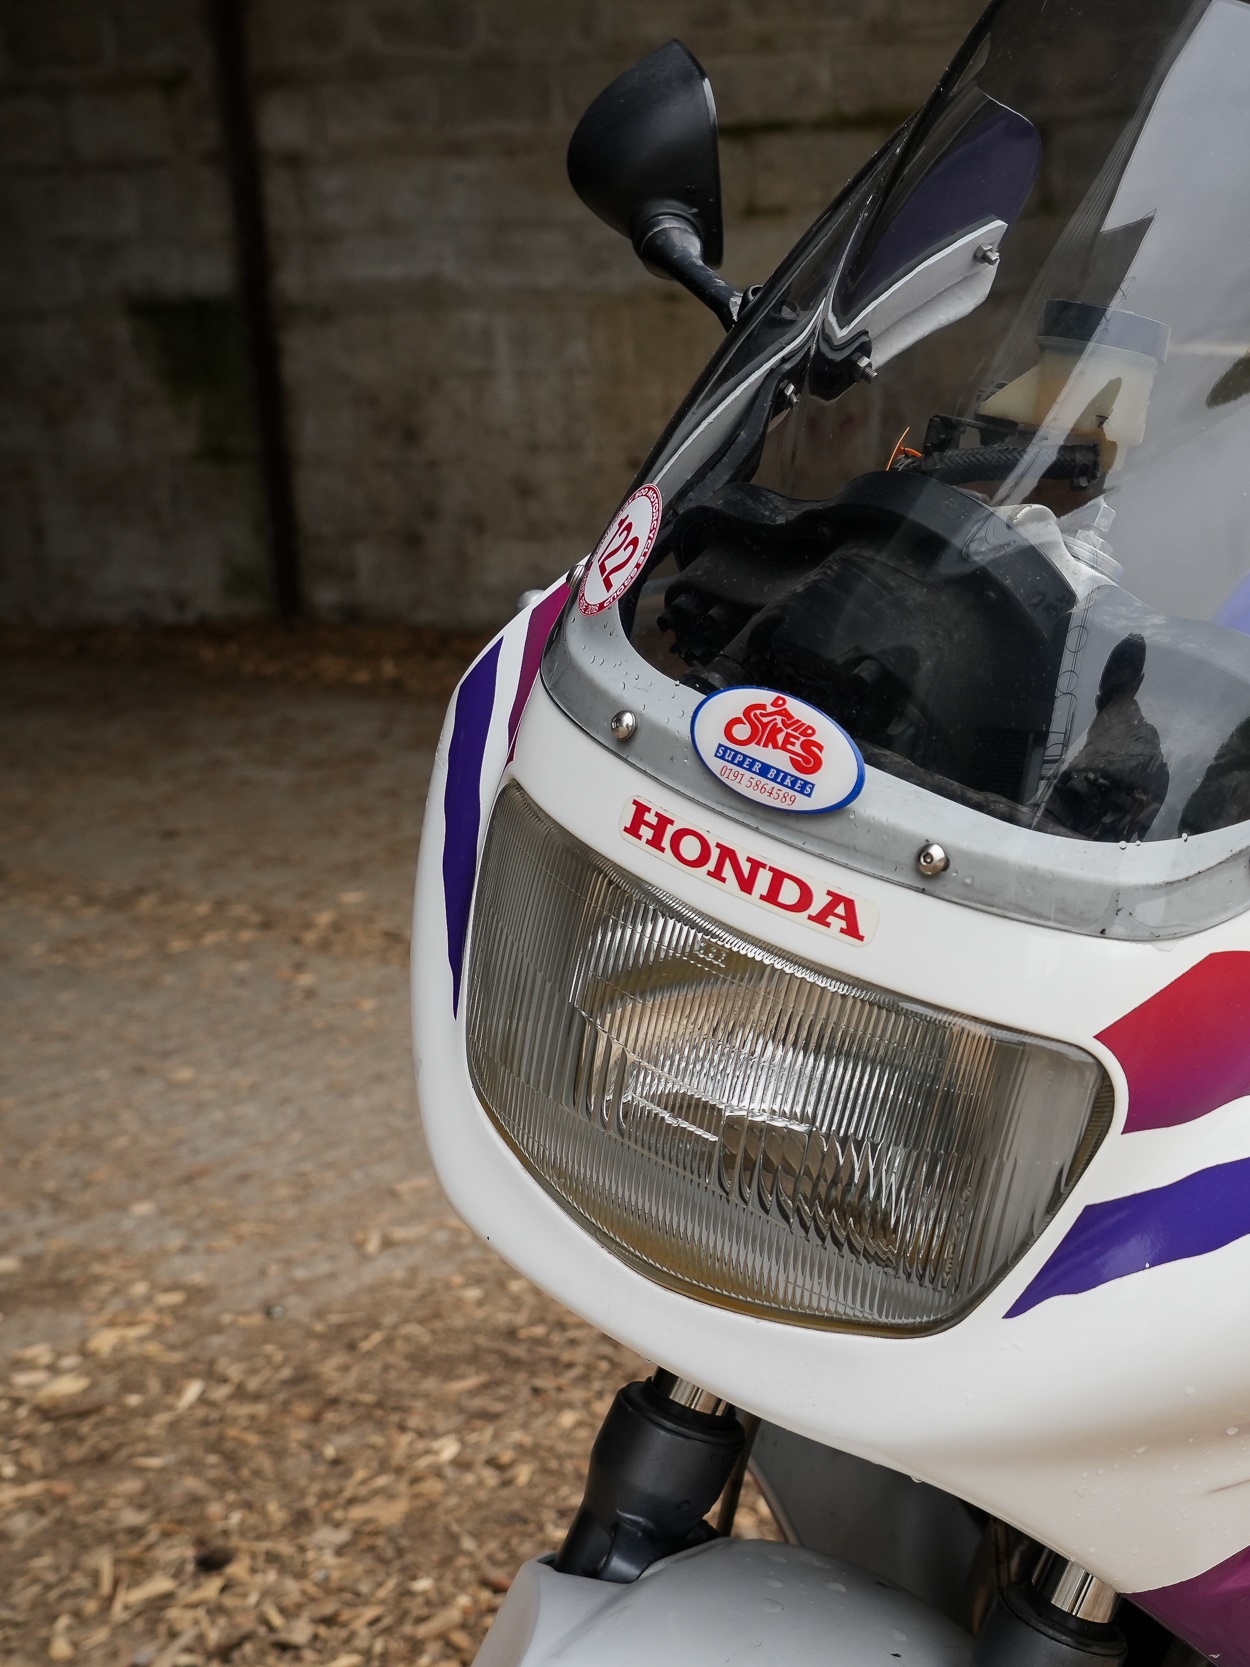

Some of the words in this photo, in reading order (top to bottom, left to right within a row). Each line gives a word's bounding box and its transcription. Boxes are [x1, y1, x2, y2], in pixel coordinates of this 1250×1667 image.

[598, 515, 639, 593] 122
[638, 489, 659, 564] MOTORCYCLE
[603, 567, 638, 607] GROUP
[724, 703, 825, 775] SYKES
[760, 695, 816, 738] DAVID
[716, 746, 762, 773] SUPER
[767, 768, 813, 794] BIKES
[720, 765, 745, 785] 0191
[745, 776, 797, 806] 5864589
[623, 799, 865, 942] HONDA
